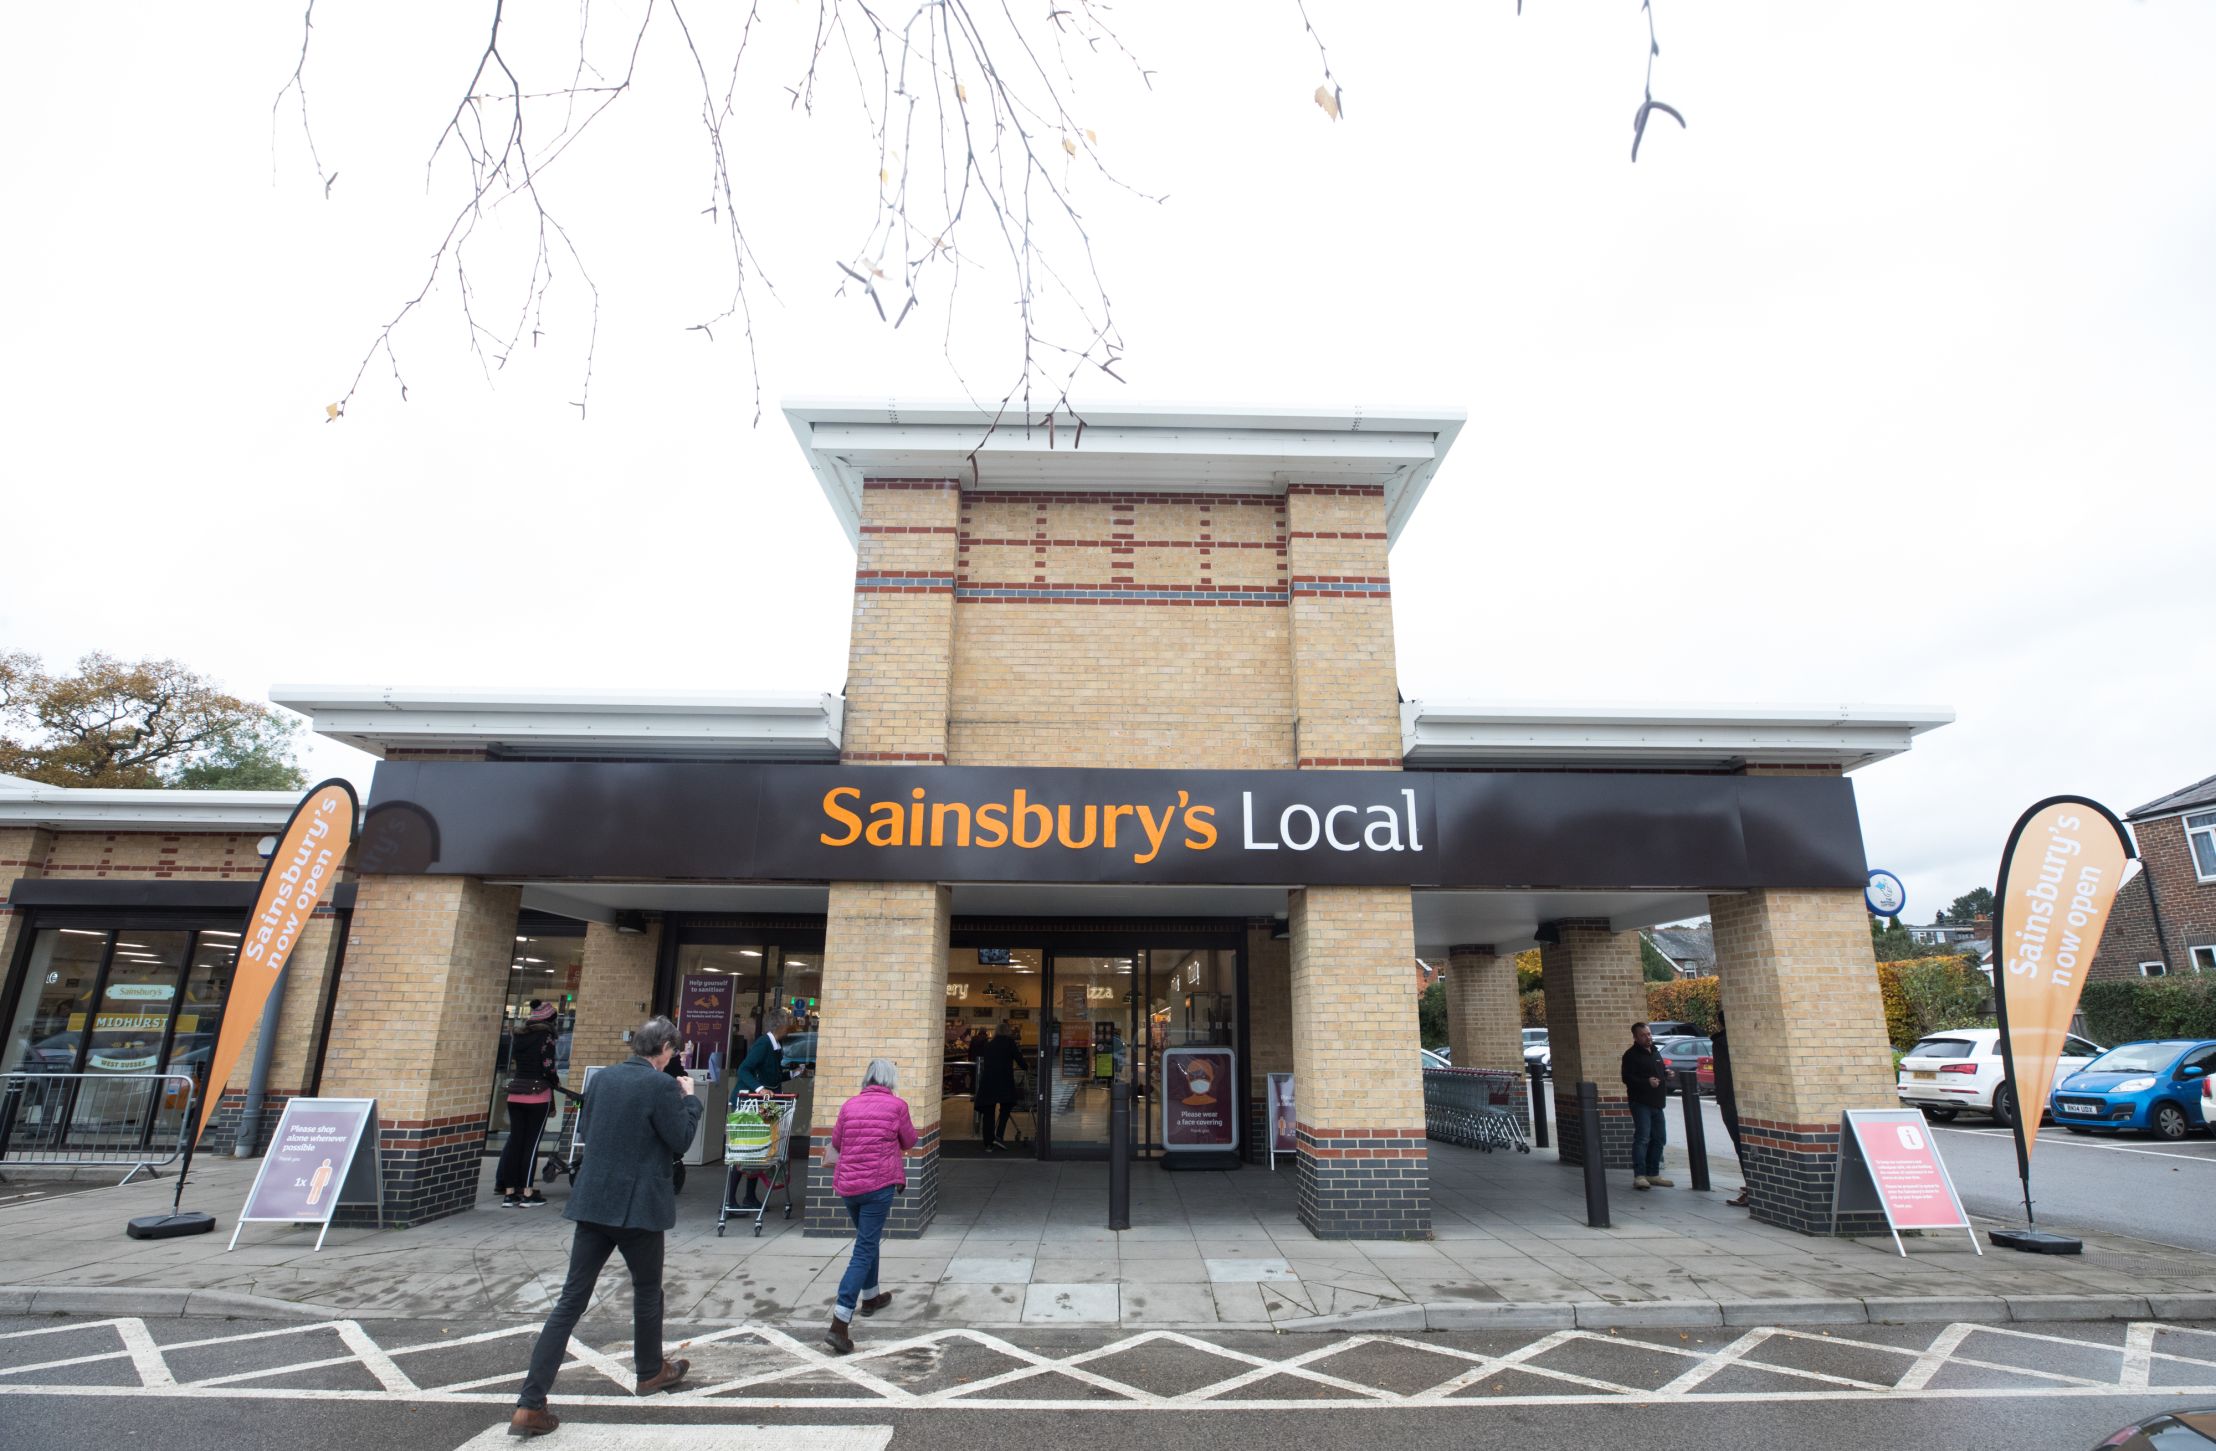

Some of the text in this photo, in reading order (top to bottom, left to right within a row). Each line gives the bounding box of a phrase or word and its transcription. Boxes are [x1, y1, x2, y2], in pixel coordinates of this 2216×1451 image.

[820, 786, 1423, 864] Sainsbury's Local
[246, 798, 336, 962] Sainsbury's
[2009, 815, 2081, 978] Sainsbury's
[266, 849, 334, 969] now open
[2052, 865, 2102, 987] now open
[96, 1017, 169, 1028] MIDHURST
[100, 1059, 120, 1067] WEST
[1181, 1110, 1201, 1118] Please
[1196, 1119, 1223, 1127] covering
[290, 1125, 336, 1135] Please shop
[286, 1134, 347, 1142] alone whenever
[282, 1143, 316, 1153] possible
[294, 1177, 307, 1187] 1x
